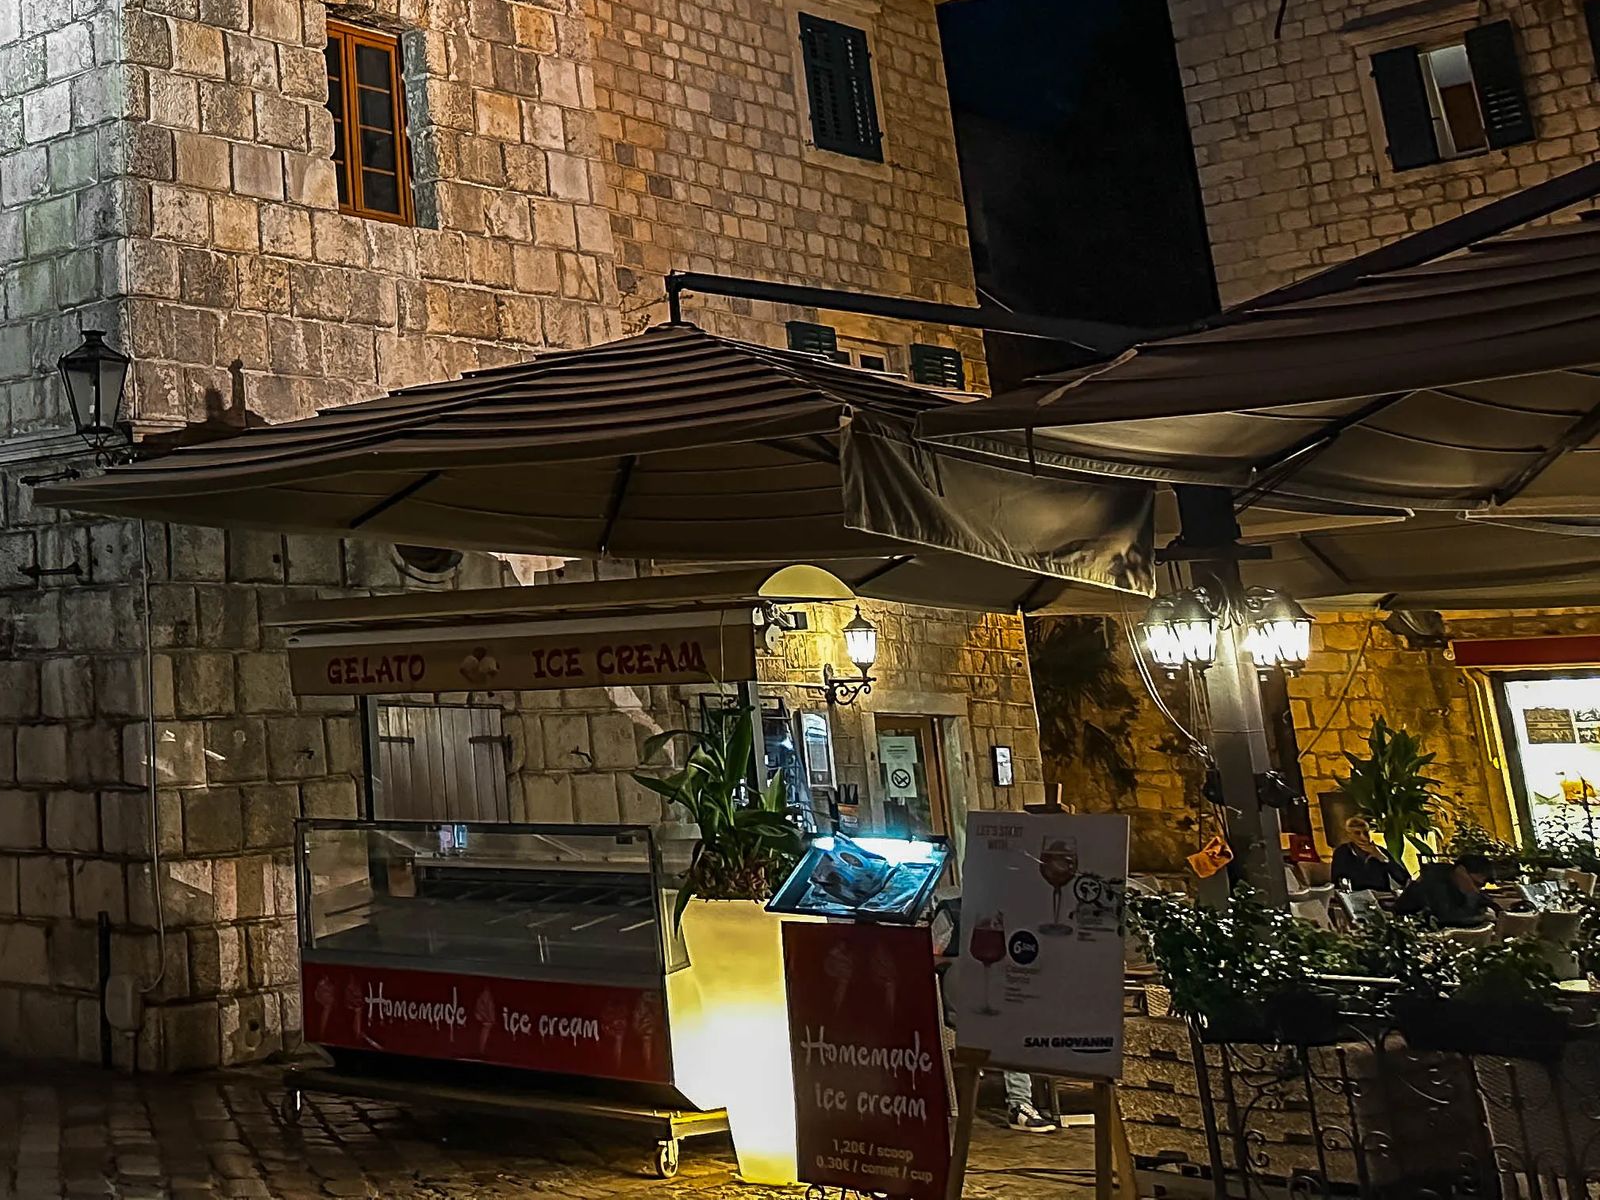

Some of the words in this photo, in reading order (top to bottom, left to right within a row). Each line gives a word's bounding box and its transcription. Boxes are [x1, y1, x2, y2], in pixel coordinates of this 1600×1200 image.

[326, 654, 426, 685] GELATO
[531, 647, 584, 678] ICE
[596, 641, 707, 677] CREAM
[364, 980, 467, 1040] Homemade
[502, 1006, 532, 1038] ice
[537, 1013, 601, 1046] cream
[800, 1024, 934, 1088] Homemade
[1024, 1036, 1049, 1048] SAN
[1051, 1036, 1114, 1048] GIOVANNI
[856, 1091, 928, 1126] cream
[876, 1146, 914, 1163] scoop
[910, 1169, 934, 1184] cup
